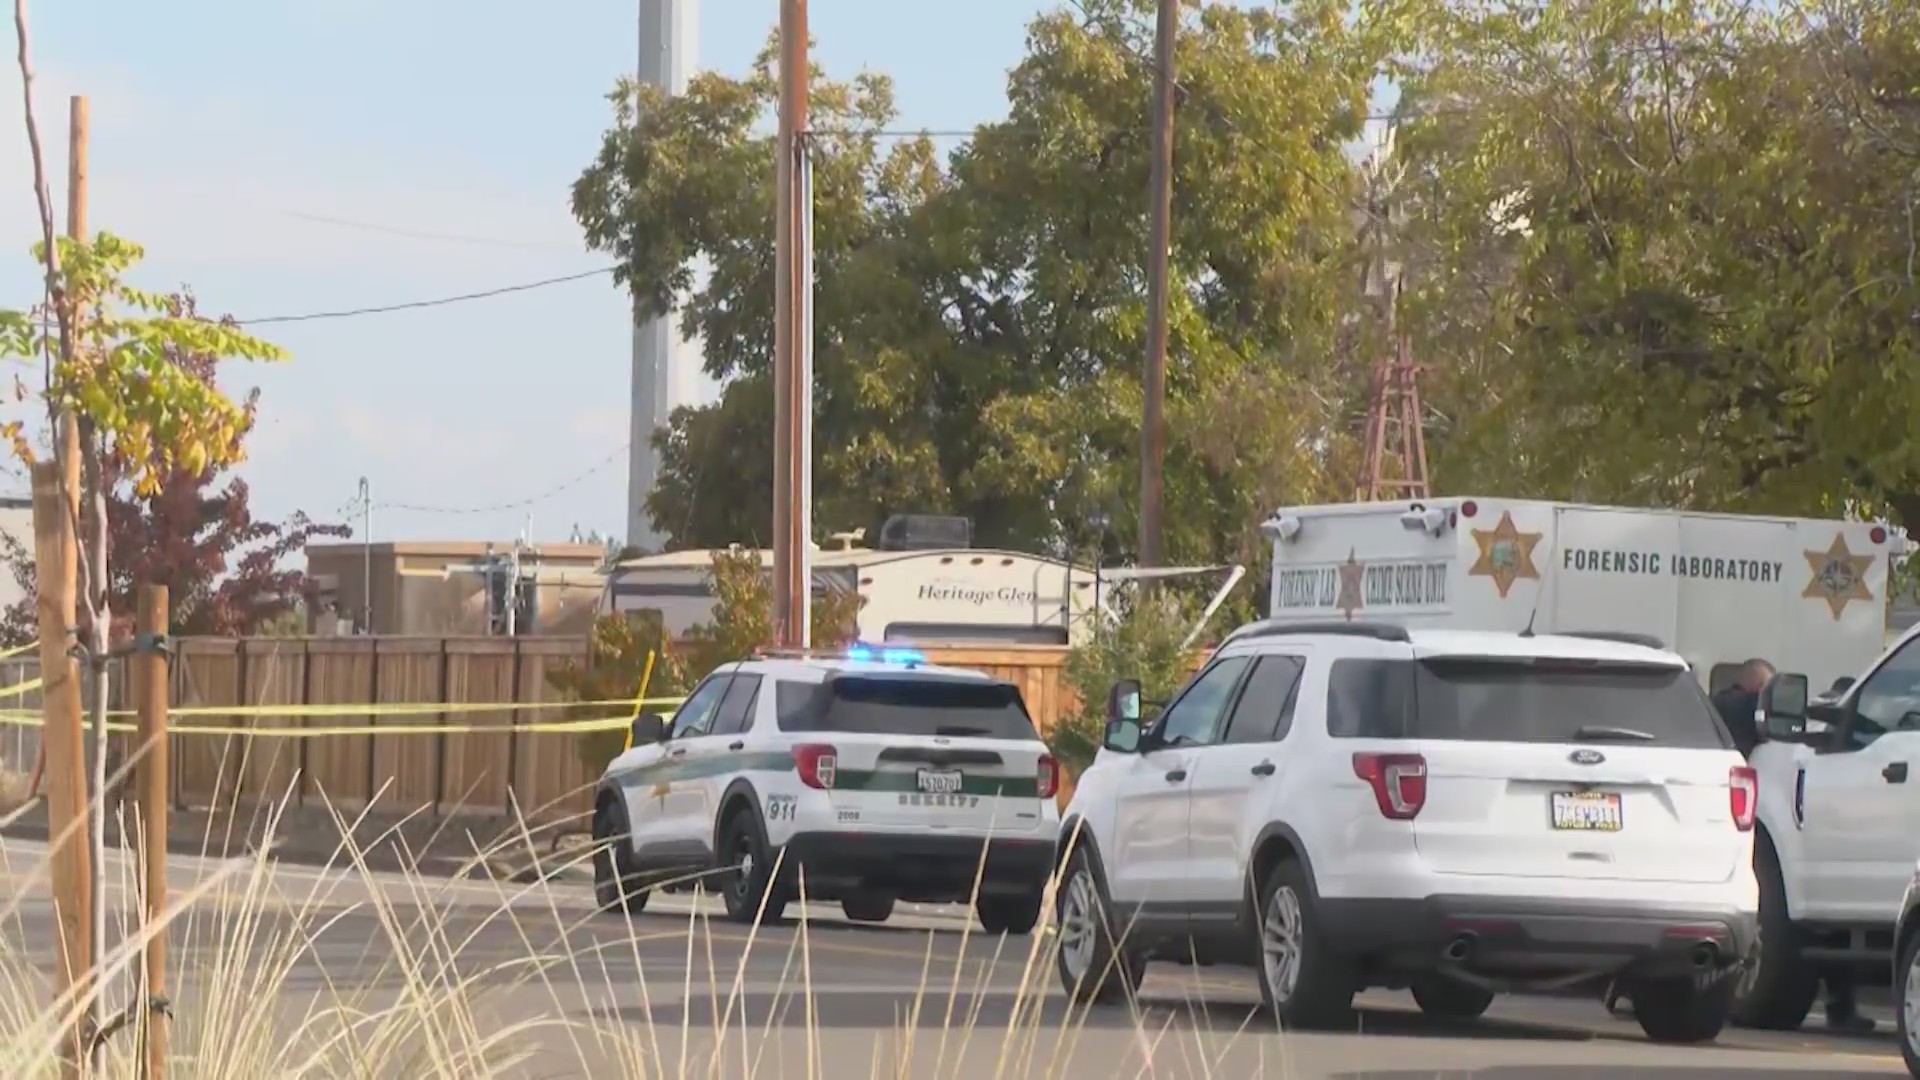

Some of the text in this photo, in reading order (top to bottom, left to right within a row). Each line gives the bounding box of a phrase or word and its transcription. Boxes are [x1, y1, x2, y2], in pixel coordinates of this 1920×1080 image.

[1564, 548, 1783, 582] FORENSIC LABORATORY
[918, 585, 1038, 606] Heritage Glen
[1319, 568, 1337, 606] LAB
[1425, 563, 1447, 604] UNIT
